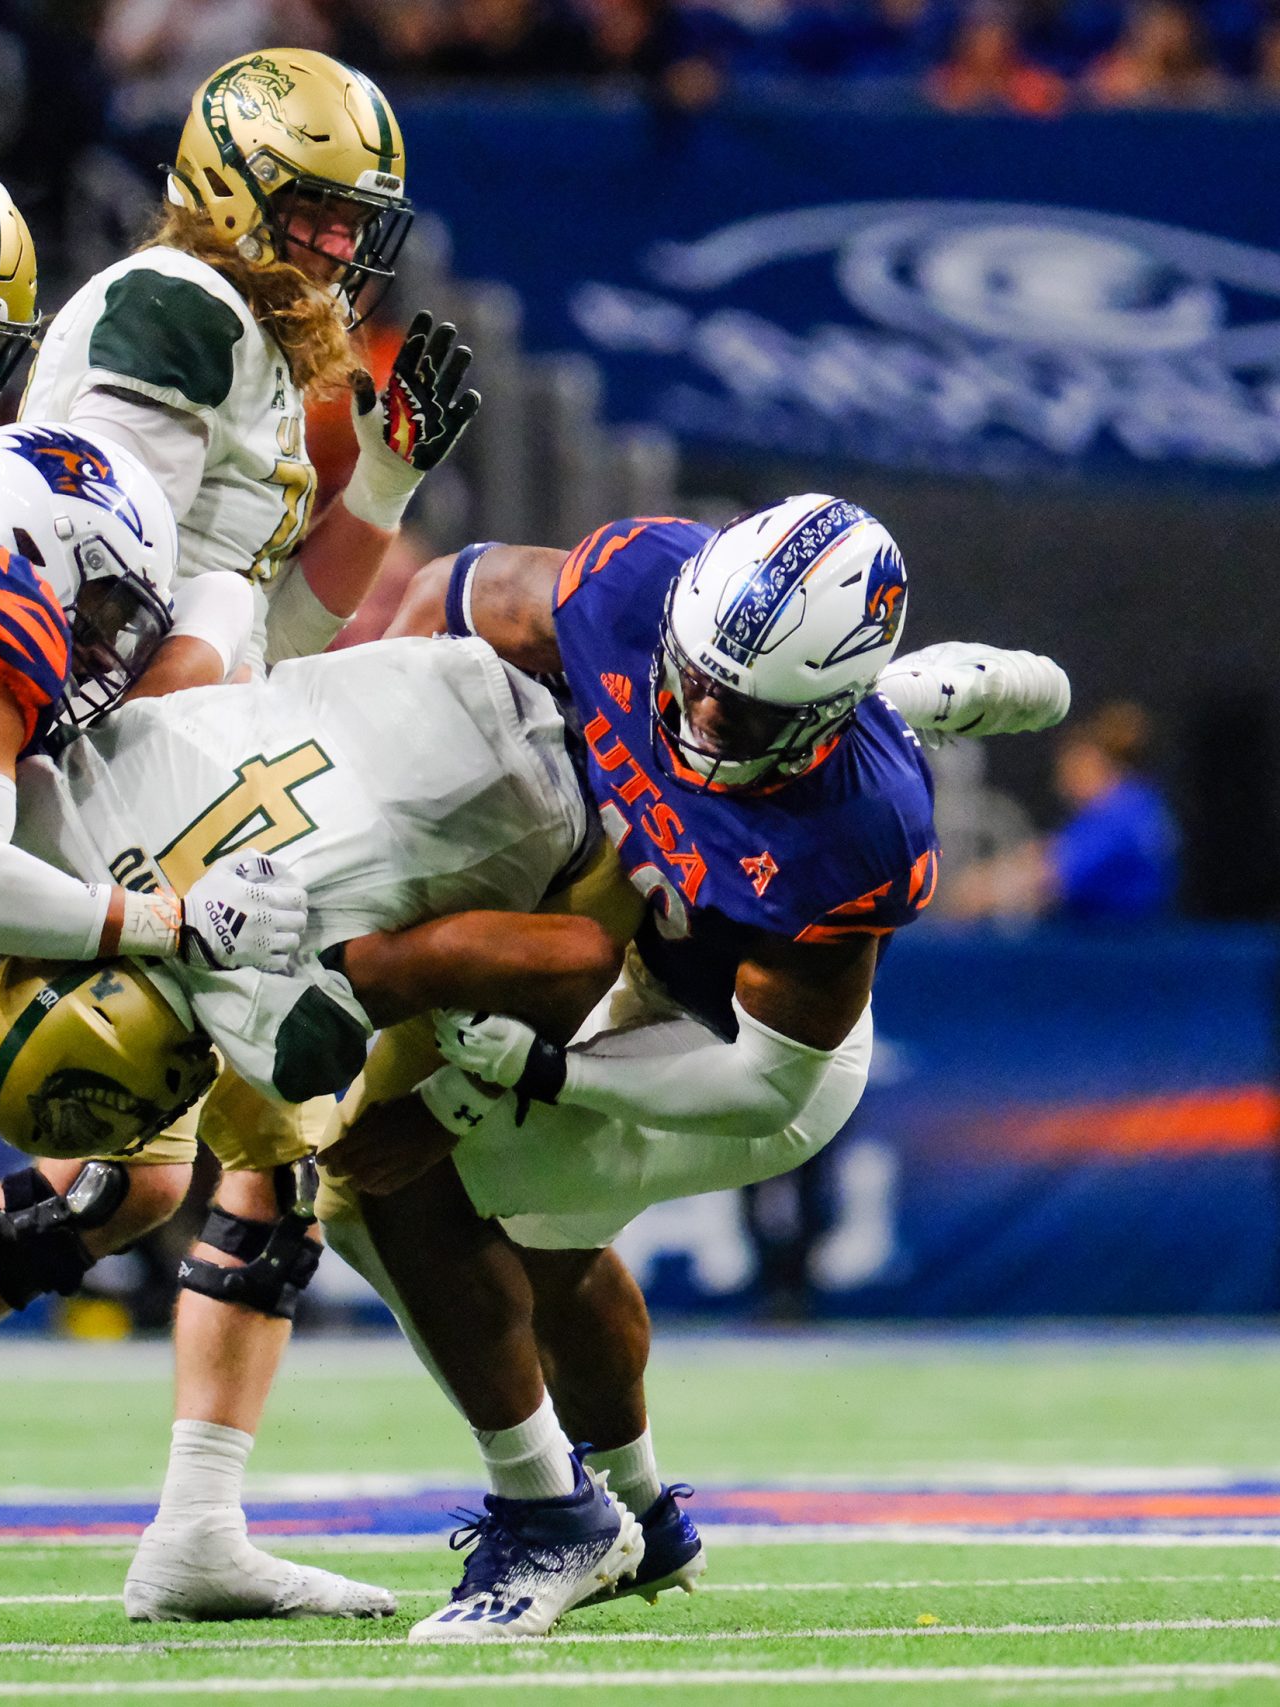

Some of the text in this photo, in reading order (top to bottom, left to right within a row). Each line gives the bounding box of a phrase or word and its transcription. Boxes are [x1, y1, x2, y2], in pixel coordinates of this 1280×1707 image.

[698, 651, 740, 686] UTSA
[153, 737, 336, 899] 4
[583, 706, 708, 906] UTSA
[204, 900, 236, 955] adidas
